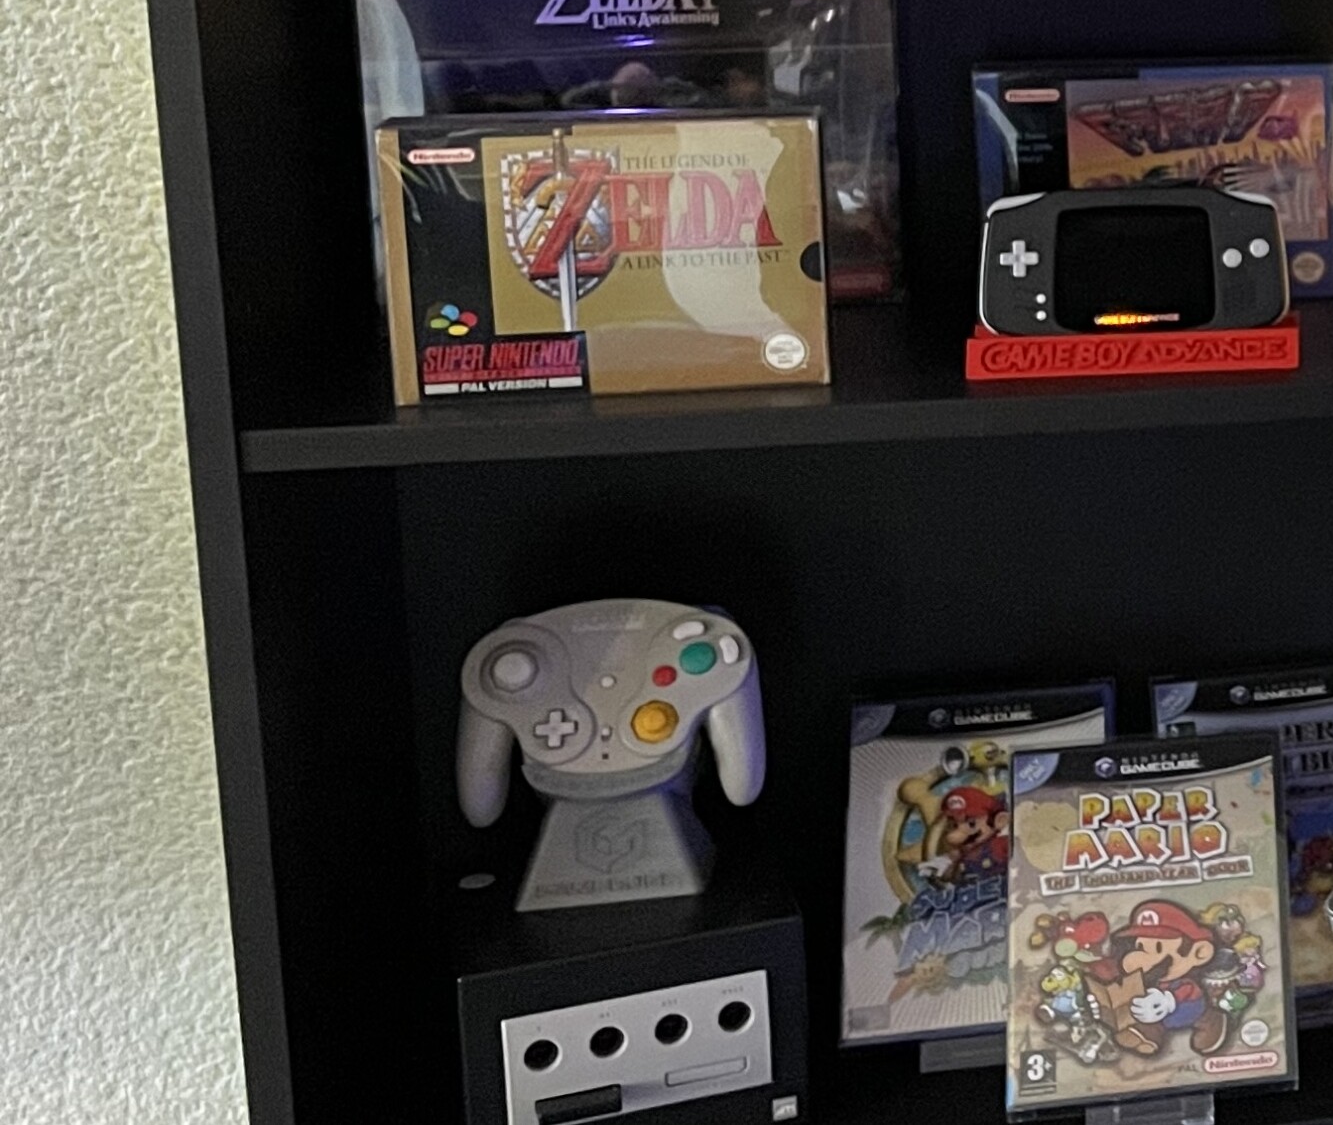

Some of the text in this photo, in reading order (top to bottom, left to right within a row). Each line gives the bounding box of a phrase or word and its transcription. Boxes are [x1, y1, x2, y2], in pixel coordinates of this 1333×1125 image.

[624, 153, 750, 170] THE LEGEND OF
[523, 159, 784, 280] ZELDA
[622, 249, 783, 271] A LINK TO THE PAST
[423, 338, 580, 373] SUPER NINTENDO
[981, 336, 1289, 373] GAME BOY ADVANCE
[460, 377, 548, 393] PAL VERSION
[1119, 758, 1201, 775] GAMECUBE
[1078, 786, 1219, 830] PAPER
[1062, 820, 1228, 871] MARIO
[1208, 1055, 1275, 1070] Nintendo
